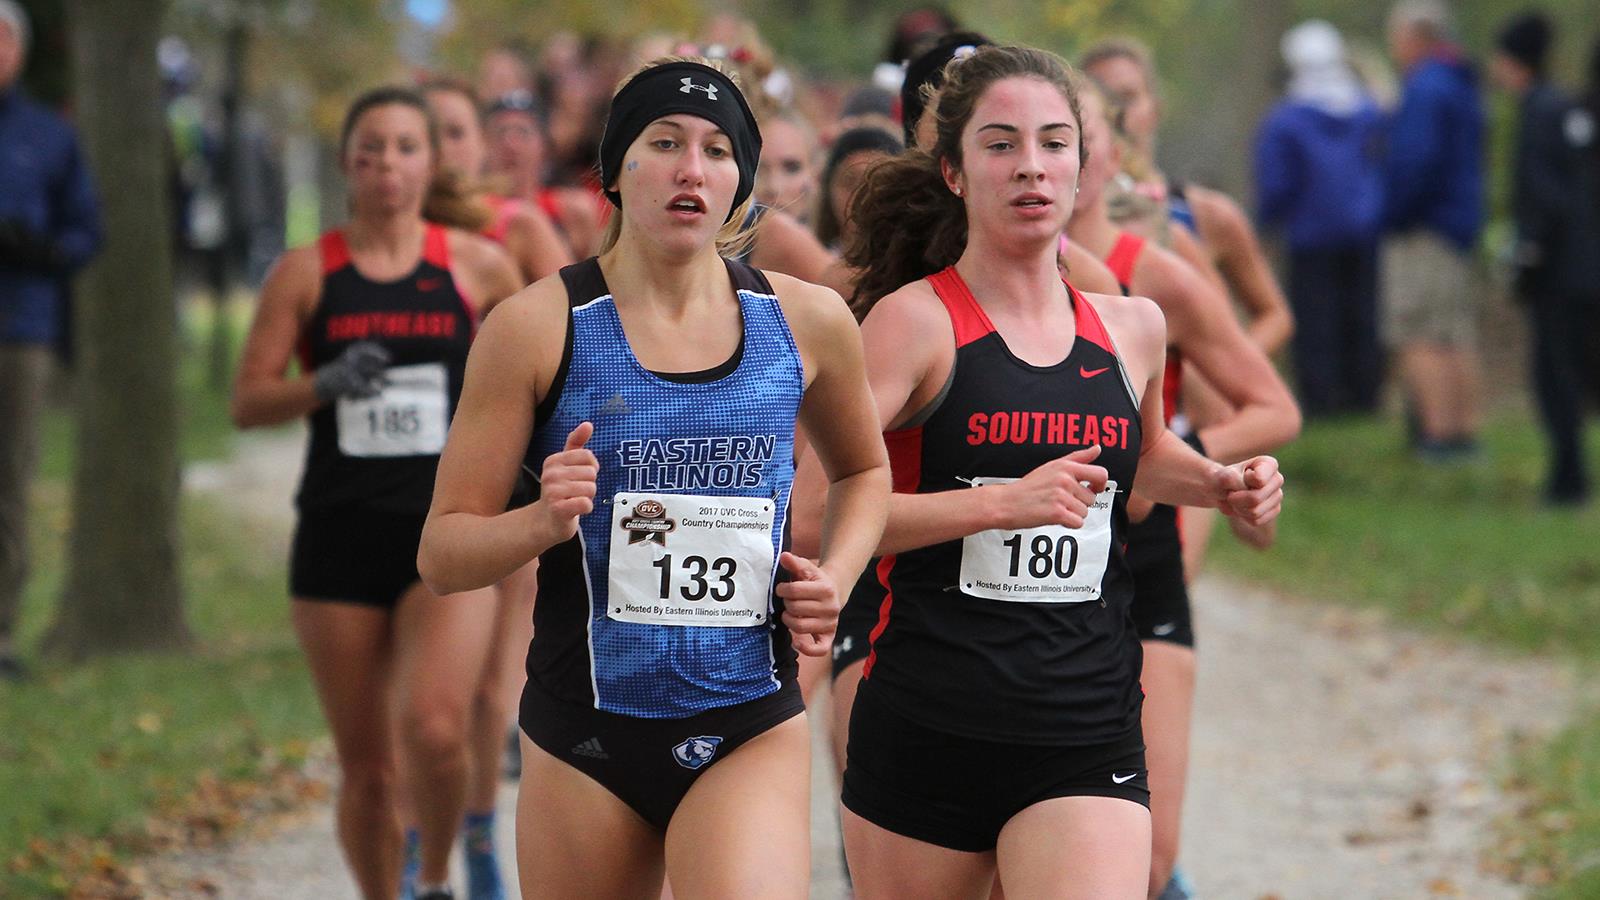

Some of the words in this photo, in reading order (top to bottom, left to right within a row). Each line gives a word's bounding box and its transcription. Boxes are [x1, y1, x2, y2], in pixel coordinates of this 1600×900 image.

[368, 404, 419, 439] 185
[966, 411, 1129, 450] SOUTHEAST
[617, 435, 776, 467] EASTERN
[628, 462, 764, 492] ILLINOIS
[682, 518, 714, 529] Country
[715, 520, 769, 531] Championships
[699, 507, 718, 516] 2017
[720, 508, 736, 517] OVC
[738, 509, 758, 518] Cross
[1003, 534, 1079, 579] 180
[653, 554, 737, 602] 133
[976, 580, 1001, 591] Hosted
[1002, 583, 1013, 593] By
[1014, 583, 1040, 593] Eastern
[1040, 584, 1062, 593] Illinois
[1063, 585, 1092, 593] University
[625, 604, 651, 614] Hosted
[653, 606, 664, 616] By
[665, 607, 693, 616] Eastern
[695, 607, 720, 617] Illinois
[721, 608, 754, 618] University
